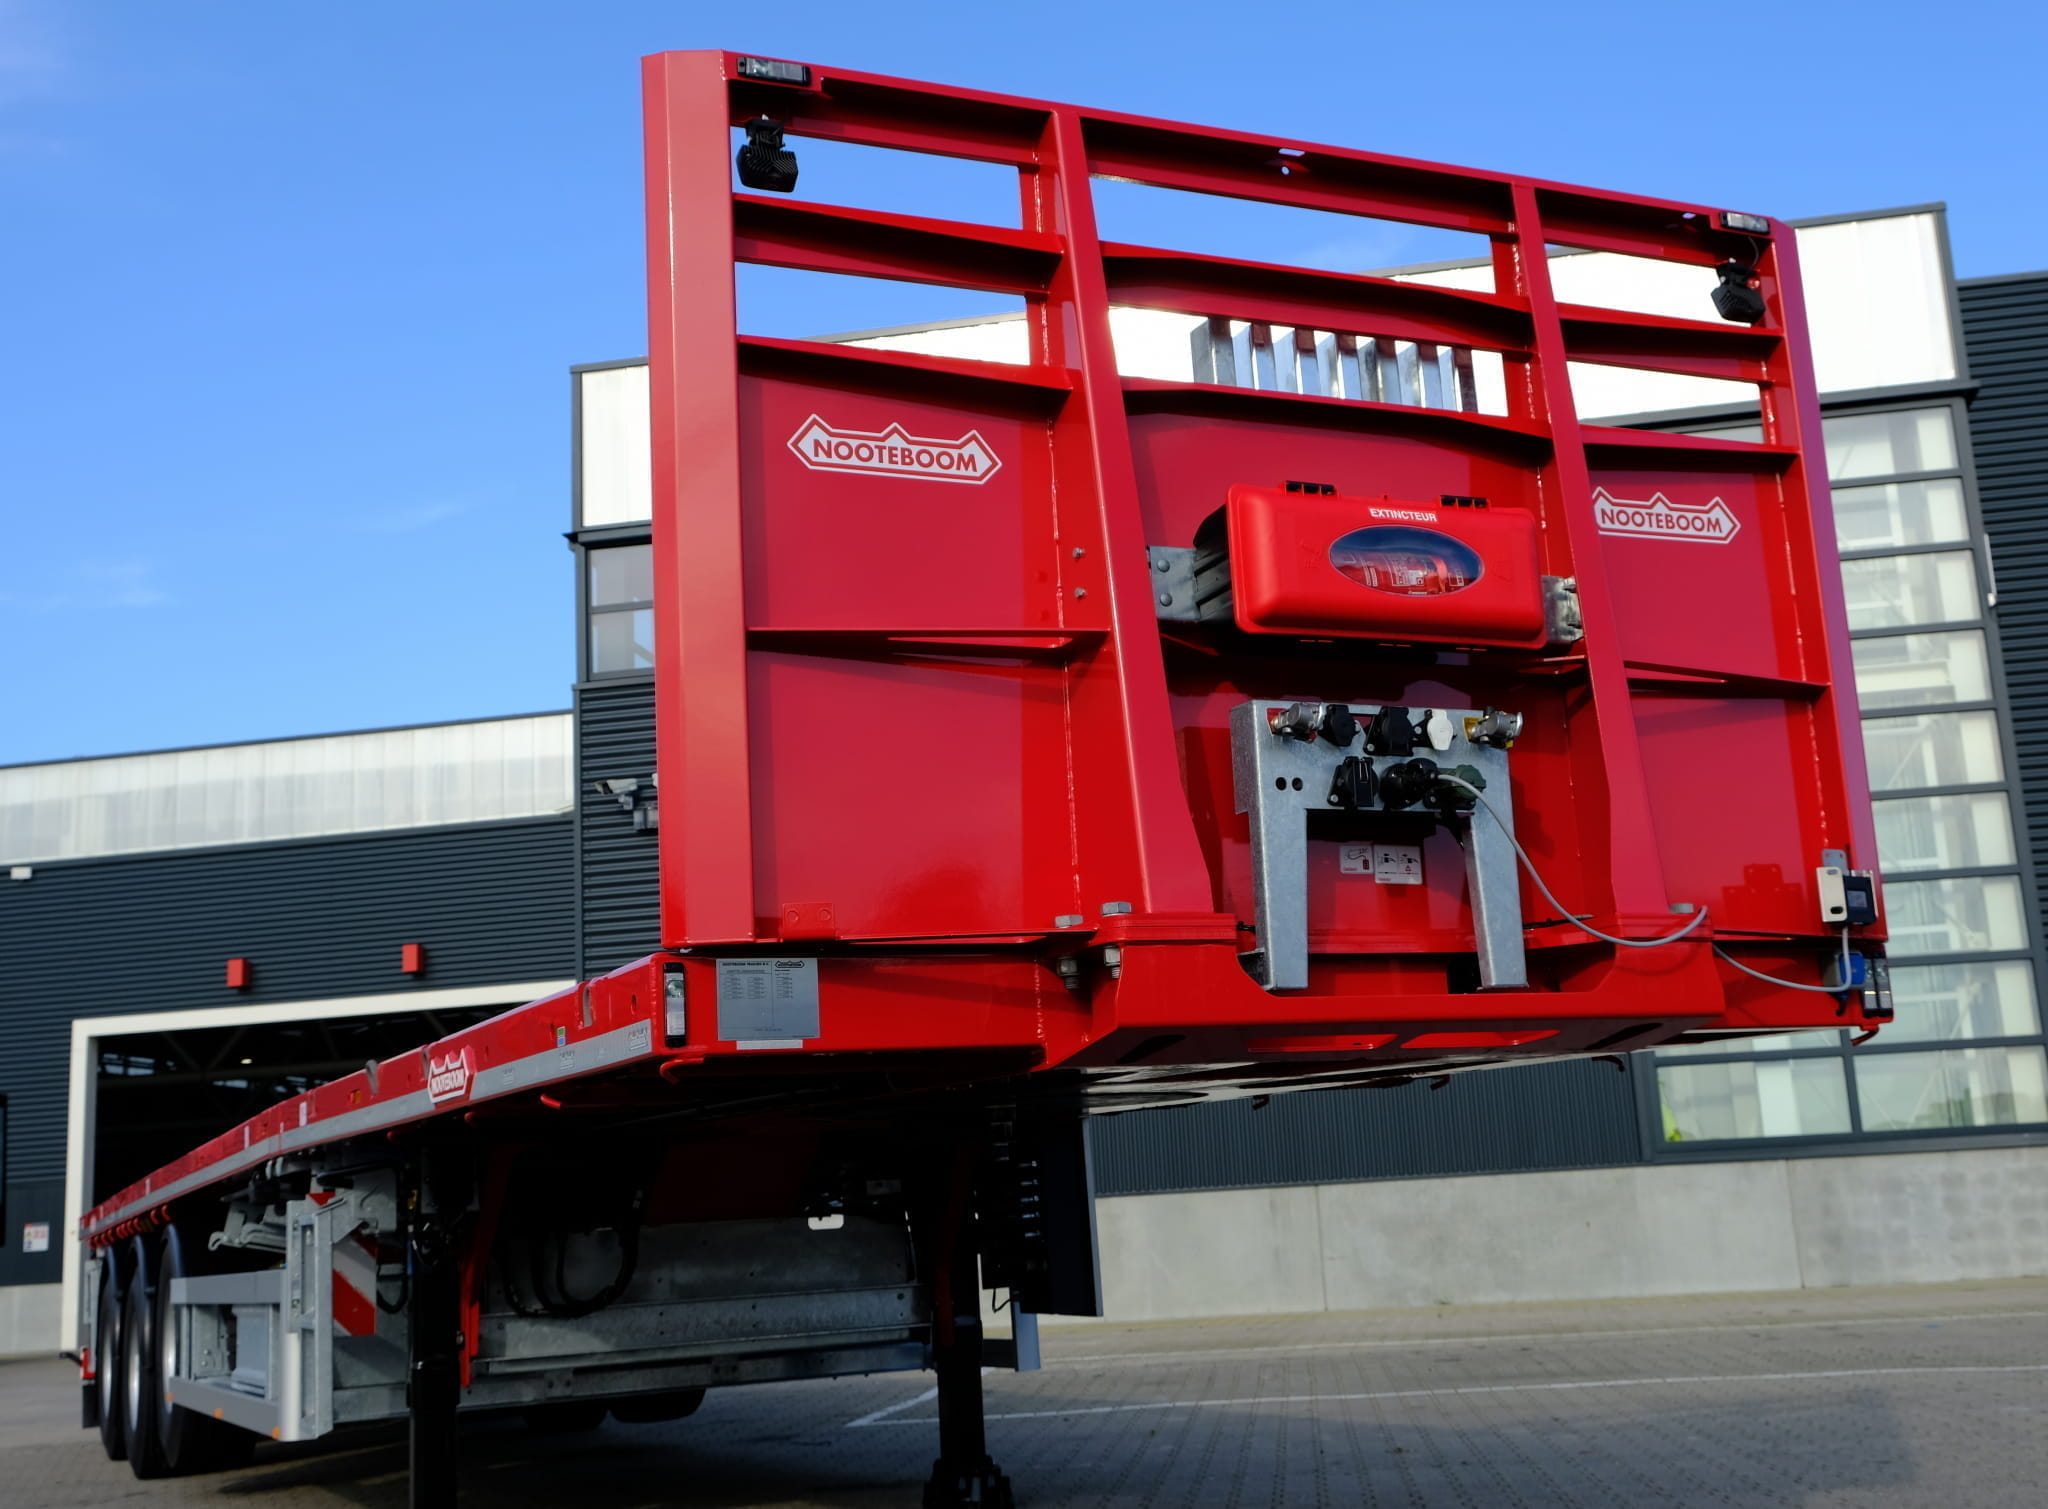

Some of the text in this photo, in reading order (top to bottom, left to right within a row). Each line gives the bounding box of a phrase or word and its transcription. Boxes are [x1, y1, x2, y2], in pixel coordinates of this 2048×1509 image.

[813, 438, 978, 473] NOOTEBOOM
[1369, 508, 1438, 522] EXTINCTEUR
[1600, 507, 1723, 534] NOOTEBOOM
